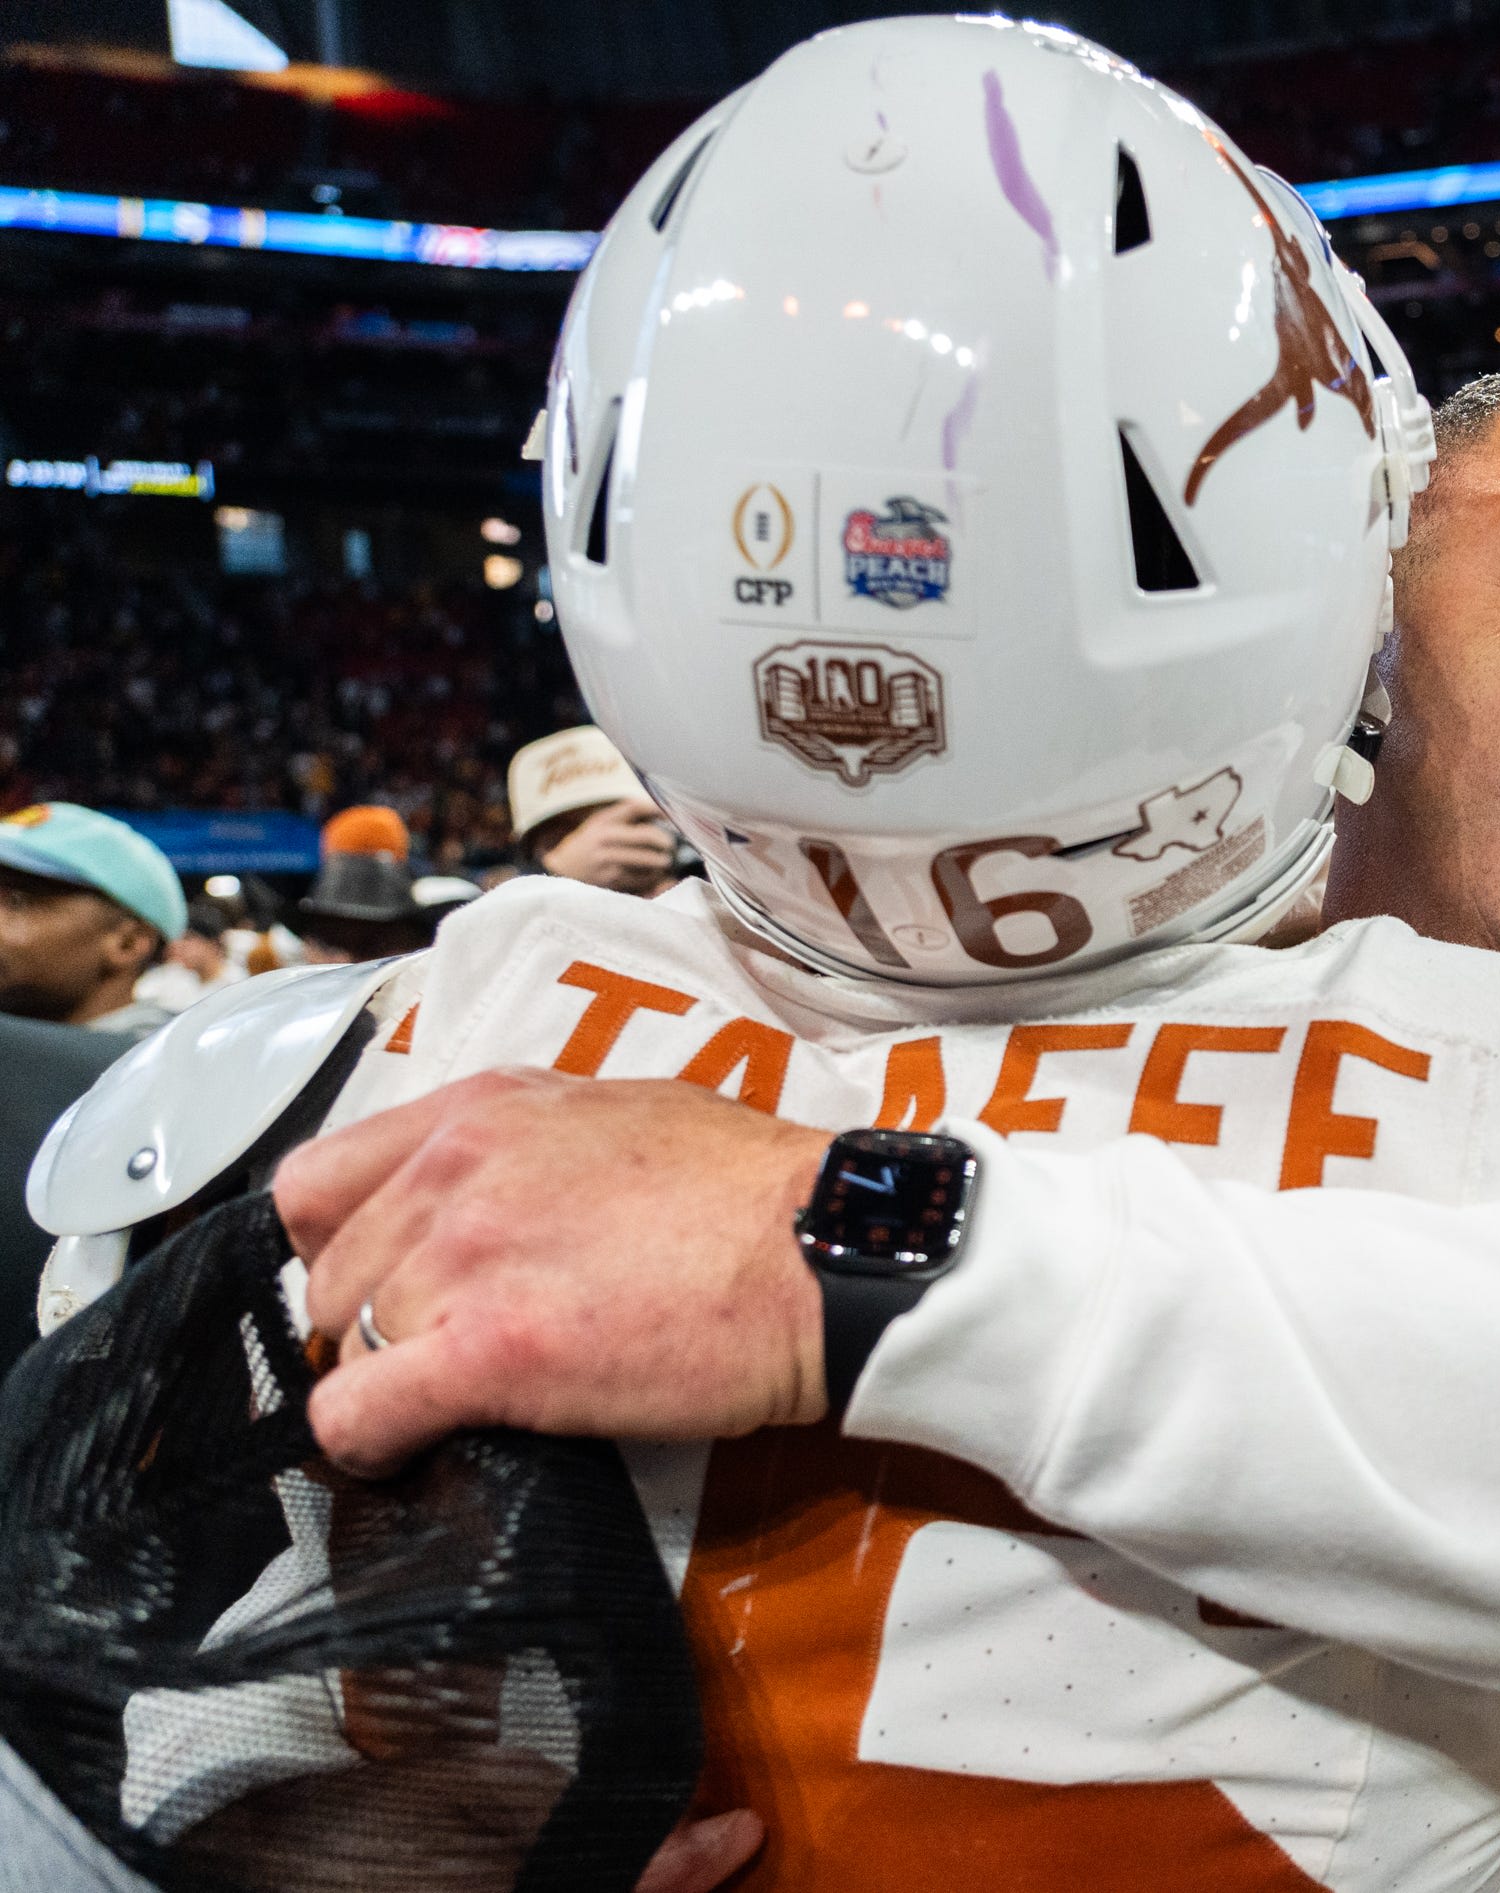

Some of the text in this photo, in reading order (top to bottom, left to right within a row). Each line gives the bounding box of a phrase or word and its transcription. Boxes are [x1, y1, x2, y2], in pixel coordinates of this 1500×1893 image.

[846, 555, 949, 586] PEACH
[734, 576, 793, 605] CFP
[798, 835, 1093, 969] 16
